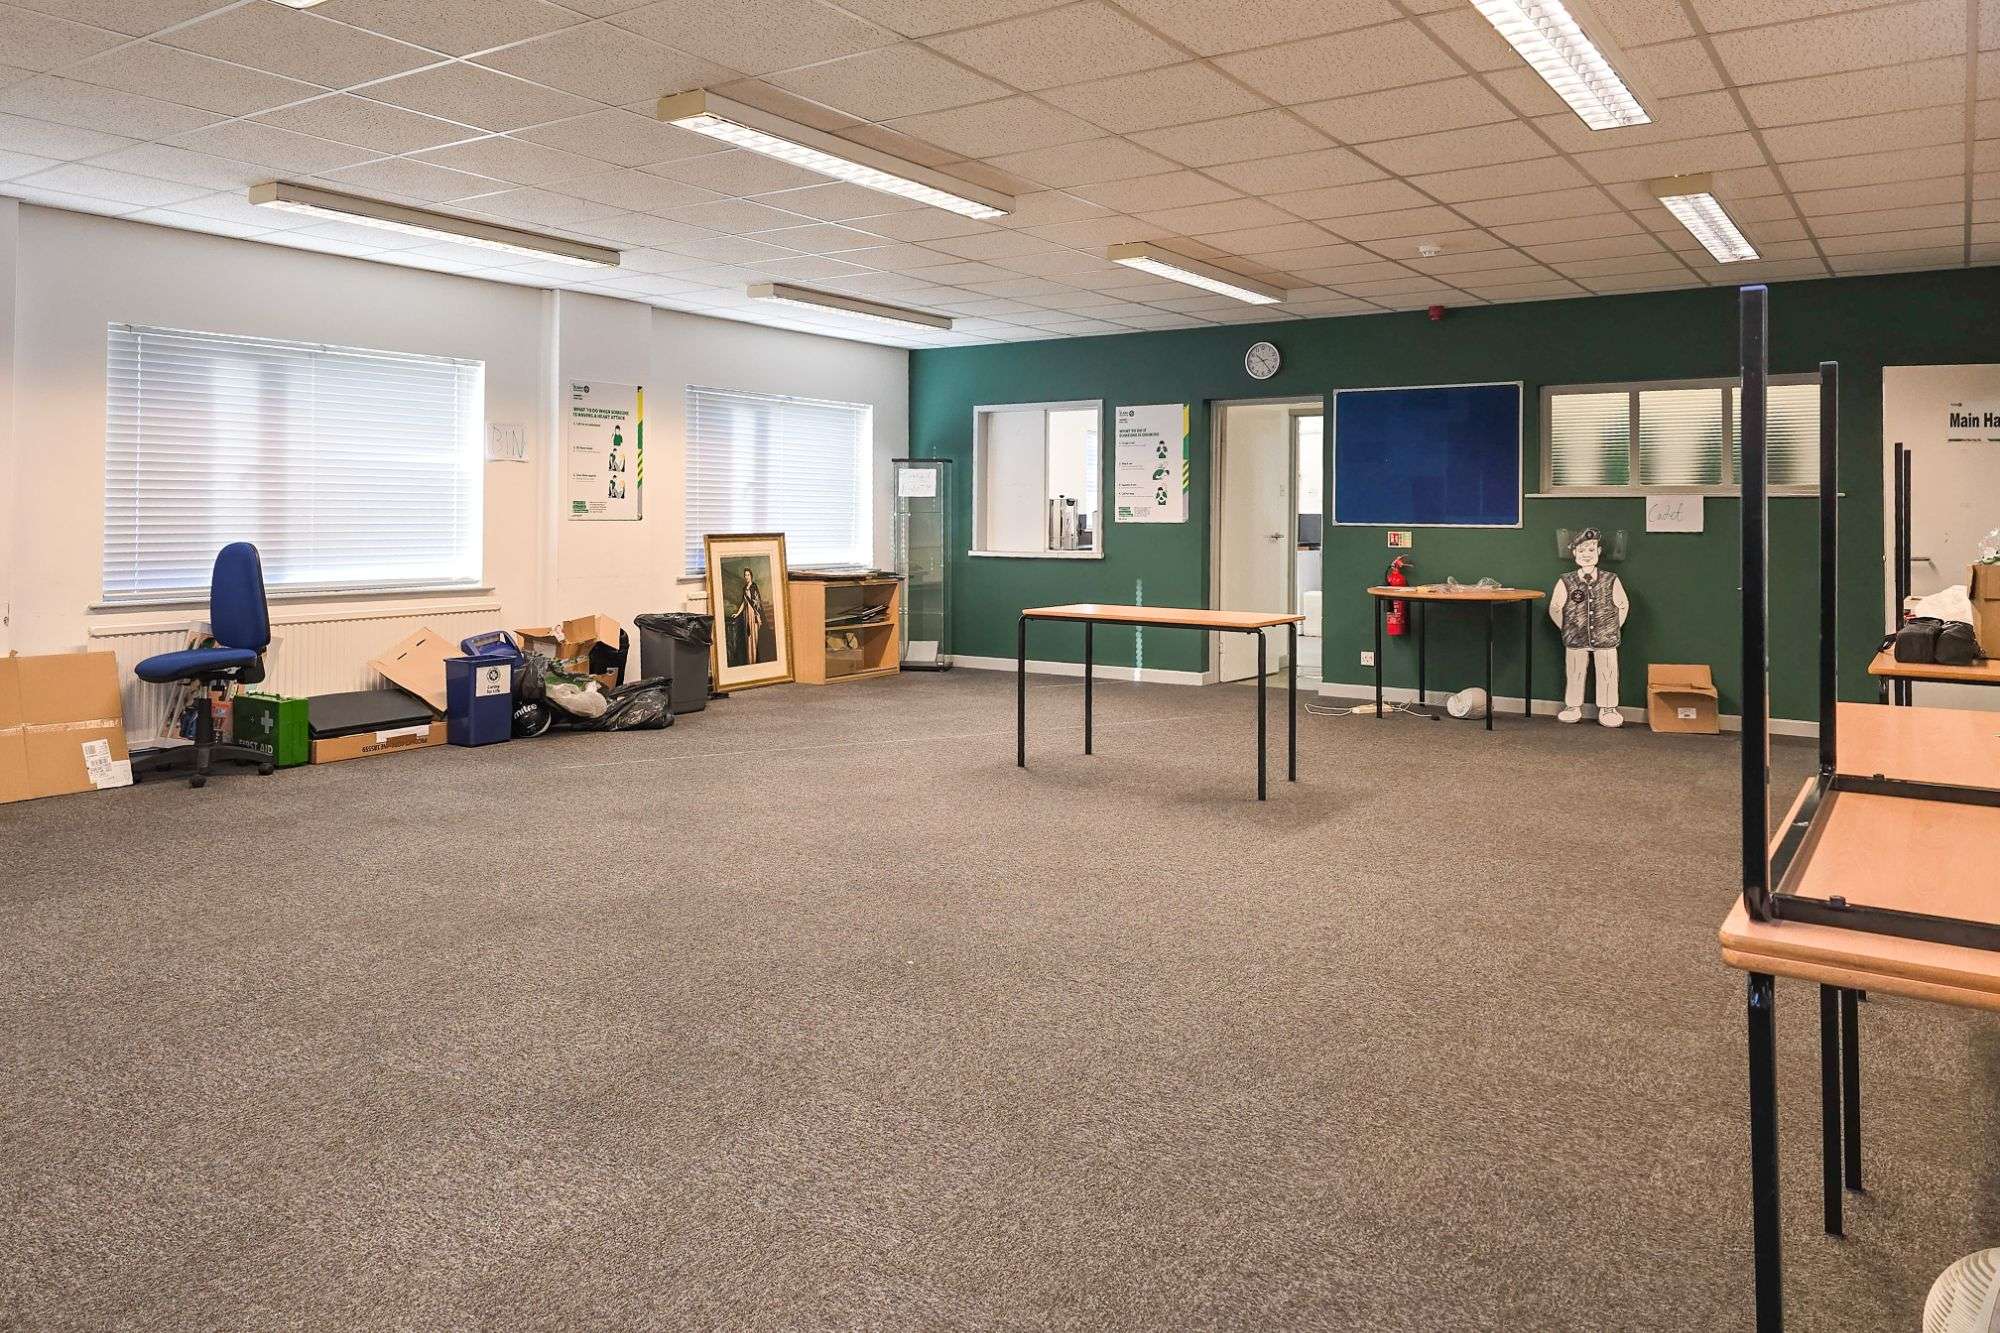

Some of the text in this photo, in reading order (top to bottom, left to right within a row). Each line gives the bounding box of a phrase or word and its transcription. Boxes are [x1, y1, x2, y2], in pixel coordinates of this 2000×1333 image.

[1950, 412, 2000, 428] Main Ha
[514, 703, 538, 720] mitre
[260, 743, 274, 754] AID
